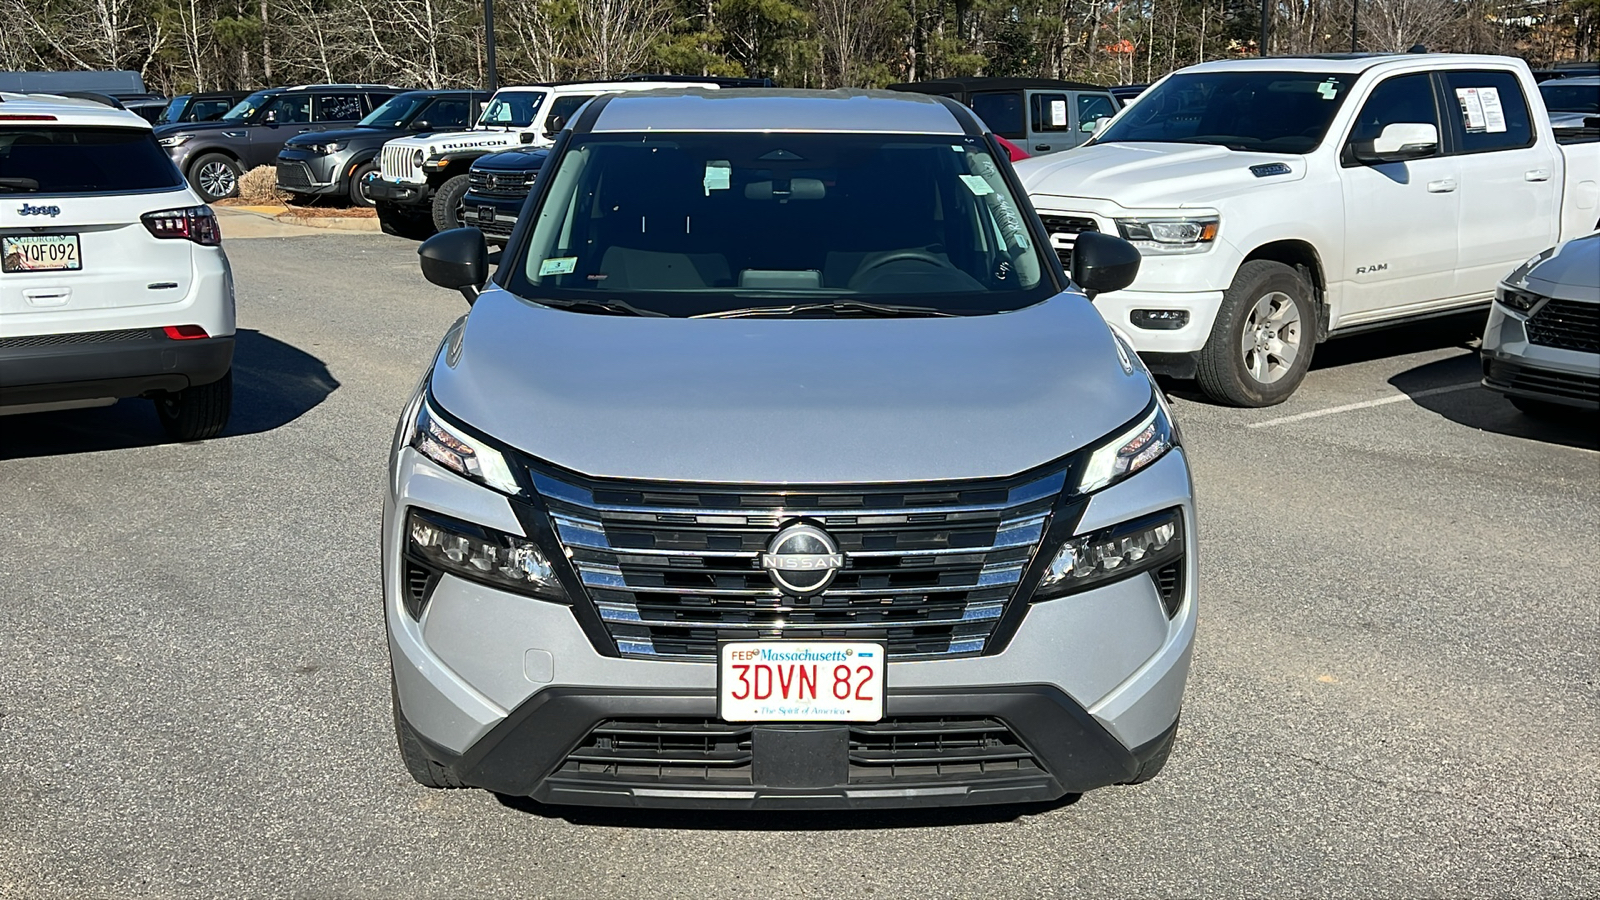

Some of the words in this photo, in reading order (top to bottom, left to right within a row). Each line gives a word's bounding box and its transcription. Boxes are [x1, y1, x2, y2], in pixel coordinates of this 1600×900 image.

[442, 140, 507, 149] RUBICON
[16, 203, 61, 218] Jeep
[22, 243, 75, 262] YQF092
[1356, 263, 1388, 274] RAM
[764, 556, 842, 568] NISSAN
[731, 651, 754, 660] FEB
[760, 649, 848, 661] Massachusetts
[731, 664, 817, 700] 3DVN
[833, 664, 874, 701] 82
[761, 707, 776, 715] The
[778, 706, 799, 716] Spirit
[801, 706, 810, 716] of
[811, 707, 845, 715] America
